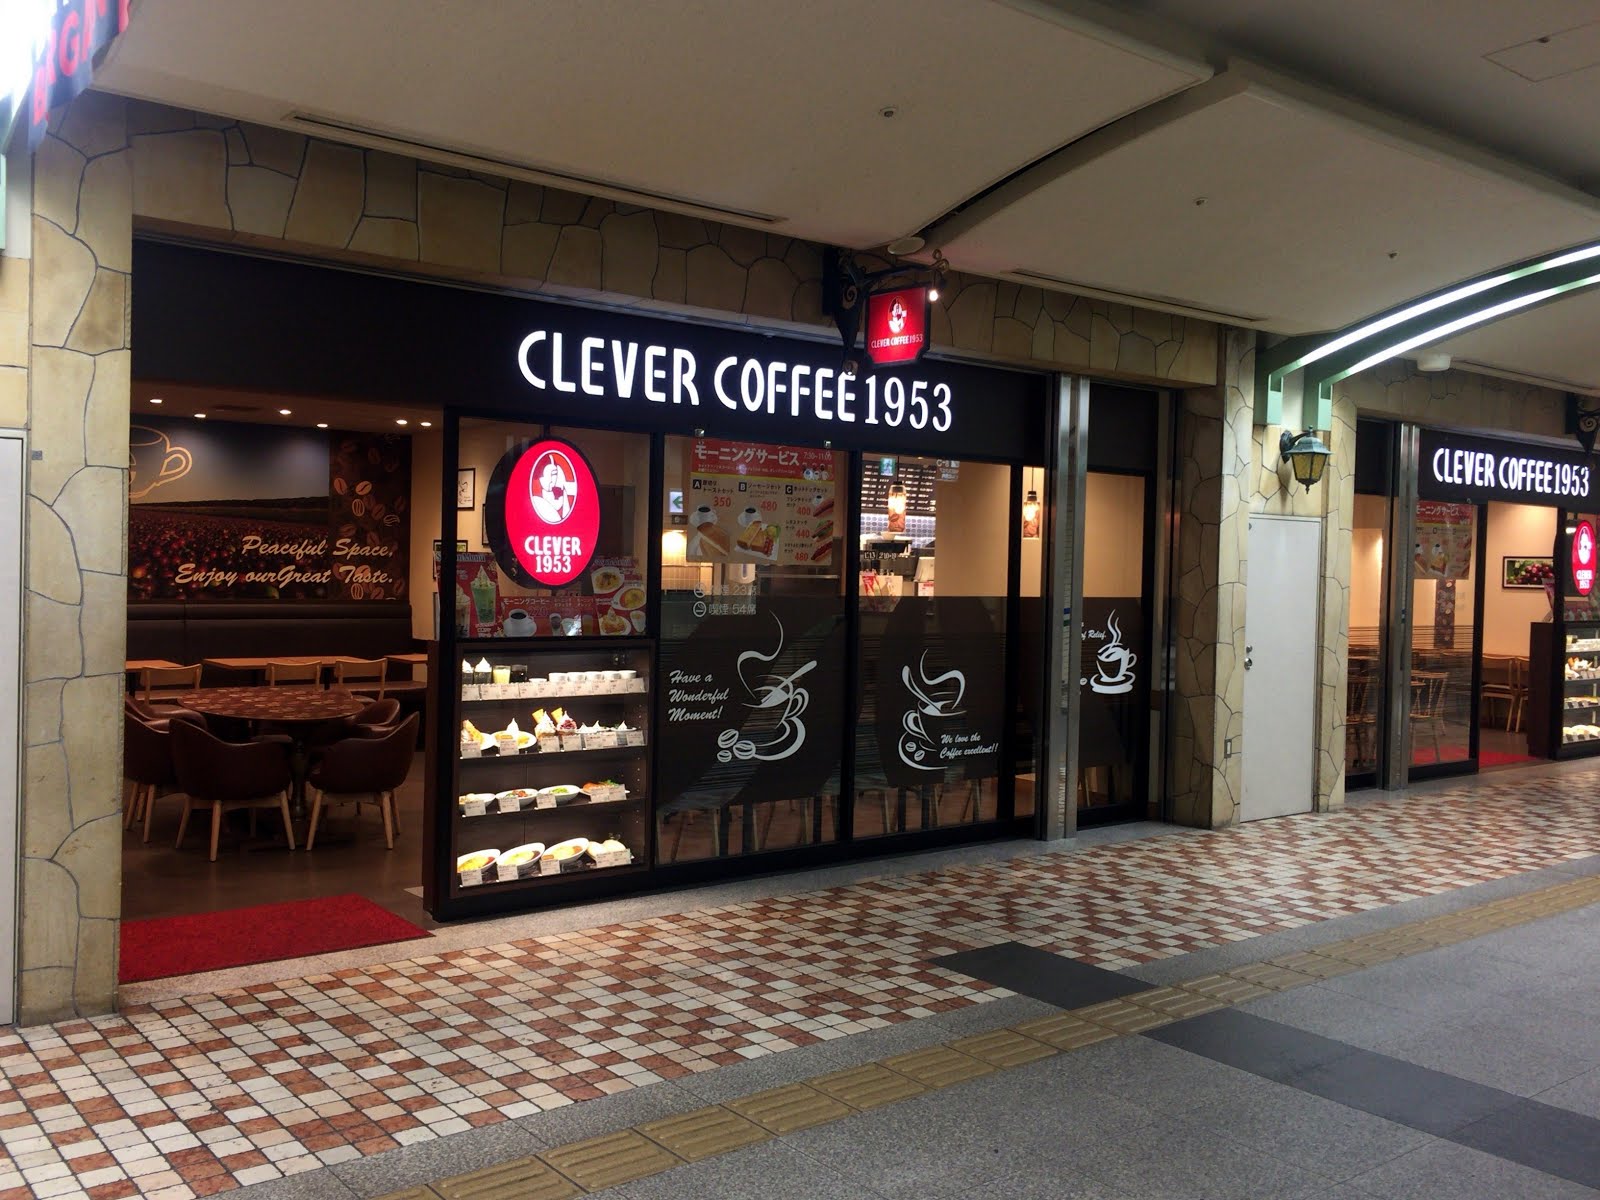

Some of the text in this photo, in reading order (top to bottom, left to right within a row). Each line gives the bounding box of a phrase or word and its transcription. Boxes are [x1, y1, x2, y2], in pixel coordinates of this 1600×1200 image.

[871, 333, 923, 348] CLEVER COFFEE 1953
[518, 330, 952, 432] CLEVER COFFEE 1953
[695, 443, 800, 466] モーニングサービス
[1433, 447, 1590, 497] CLEVER COFFEE 1953
[714, 496, 731, 507] 350
[760, 501, 777, 512] 480
[242, 535, 325, 560] Peaceful
[524, 535, 582, 556] CLEVER
[535, 555, 572, 573] 1953
[175, 563, 238, 587] Enjoy
[669, 670, 713, 684] Have a
[668, 688, 729, 704] Wonderful
[668, 705, 723, 722] Moment!
[940, 732, 981, 744] We love the
[940, 747, 963, 759] Coffee
